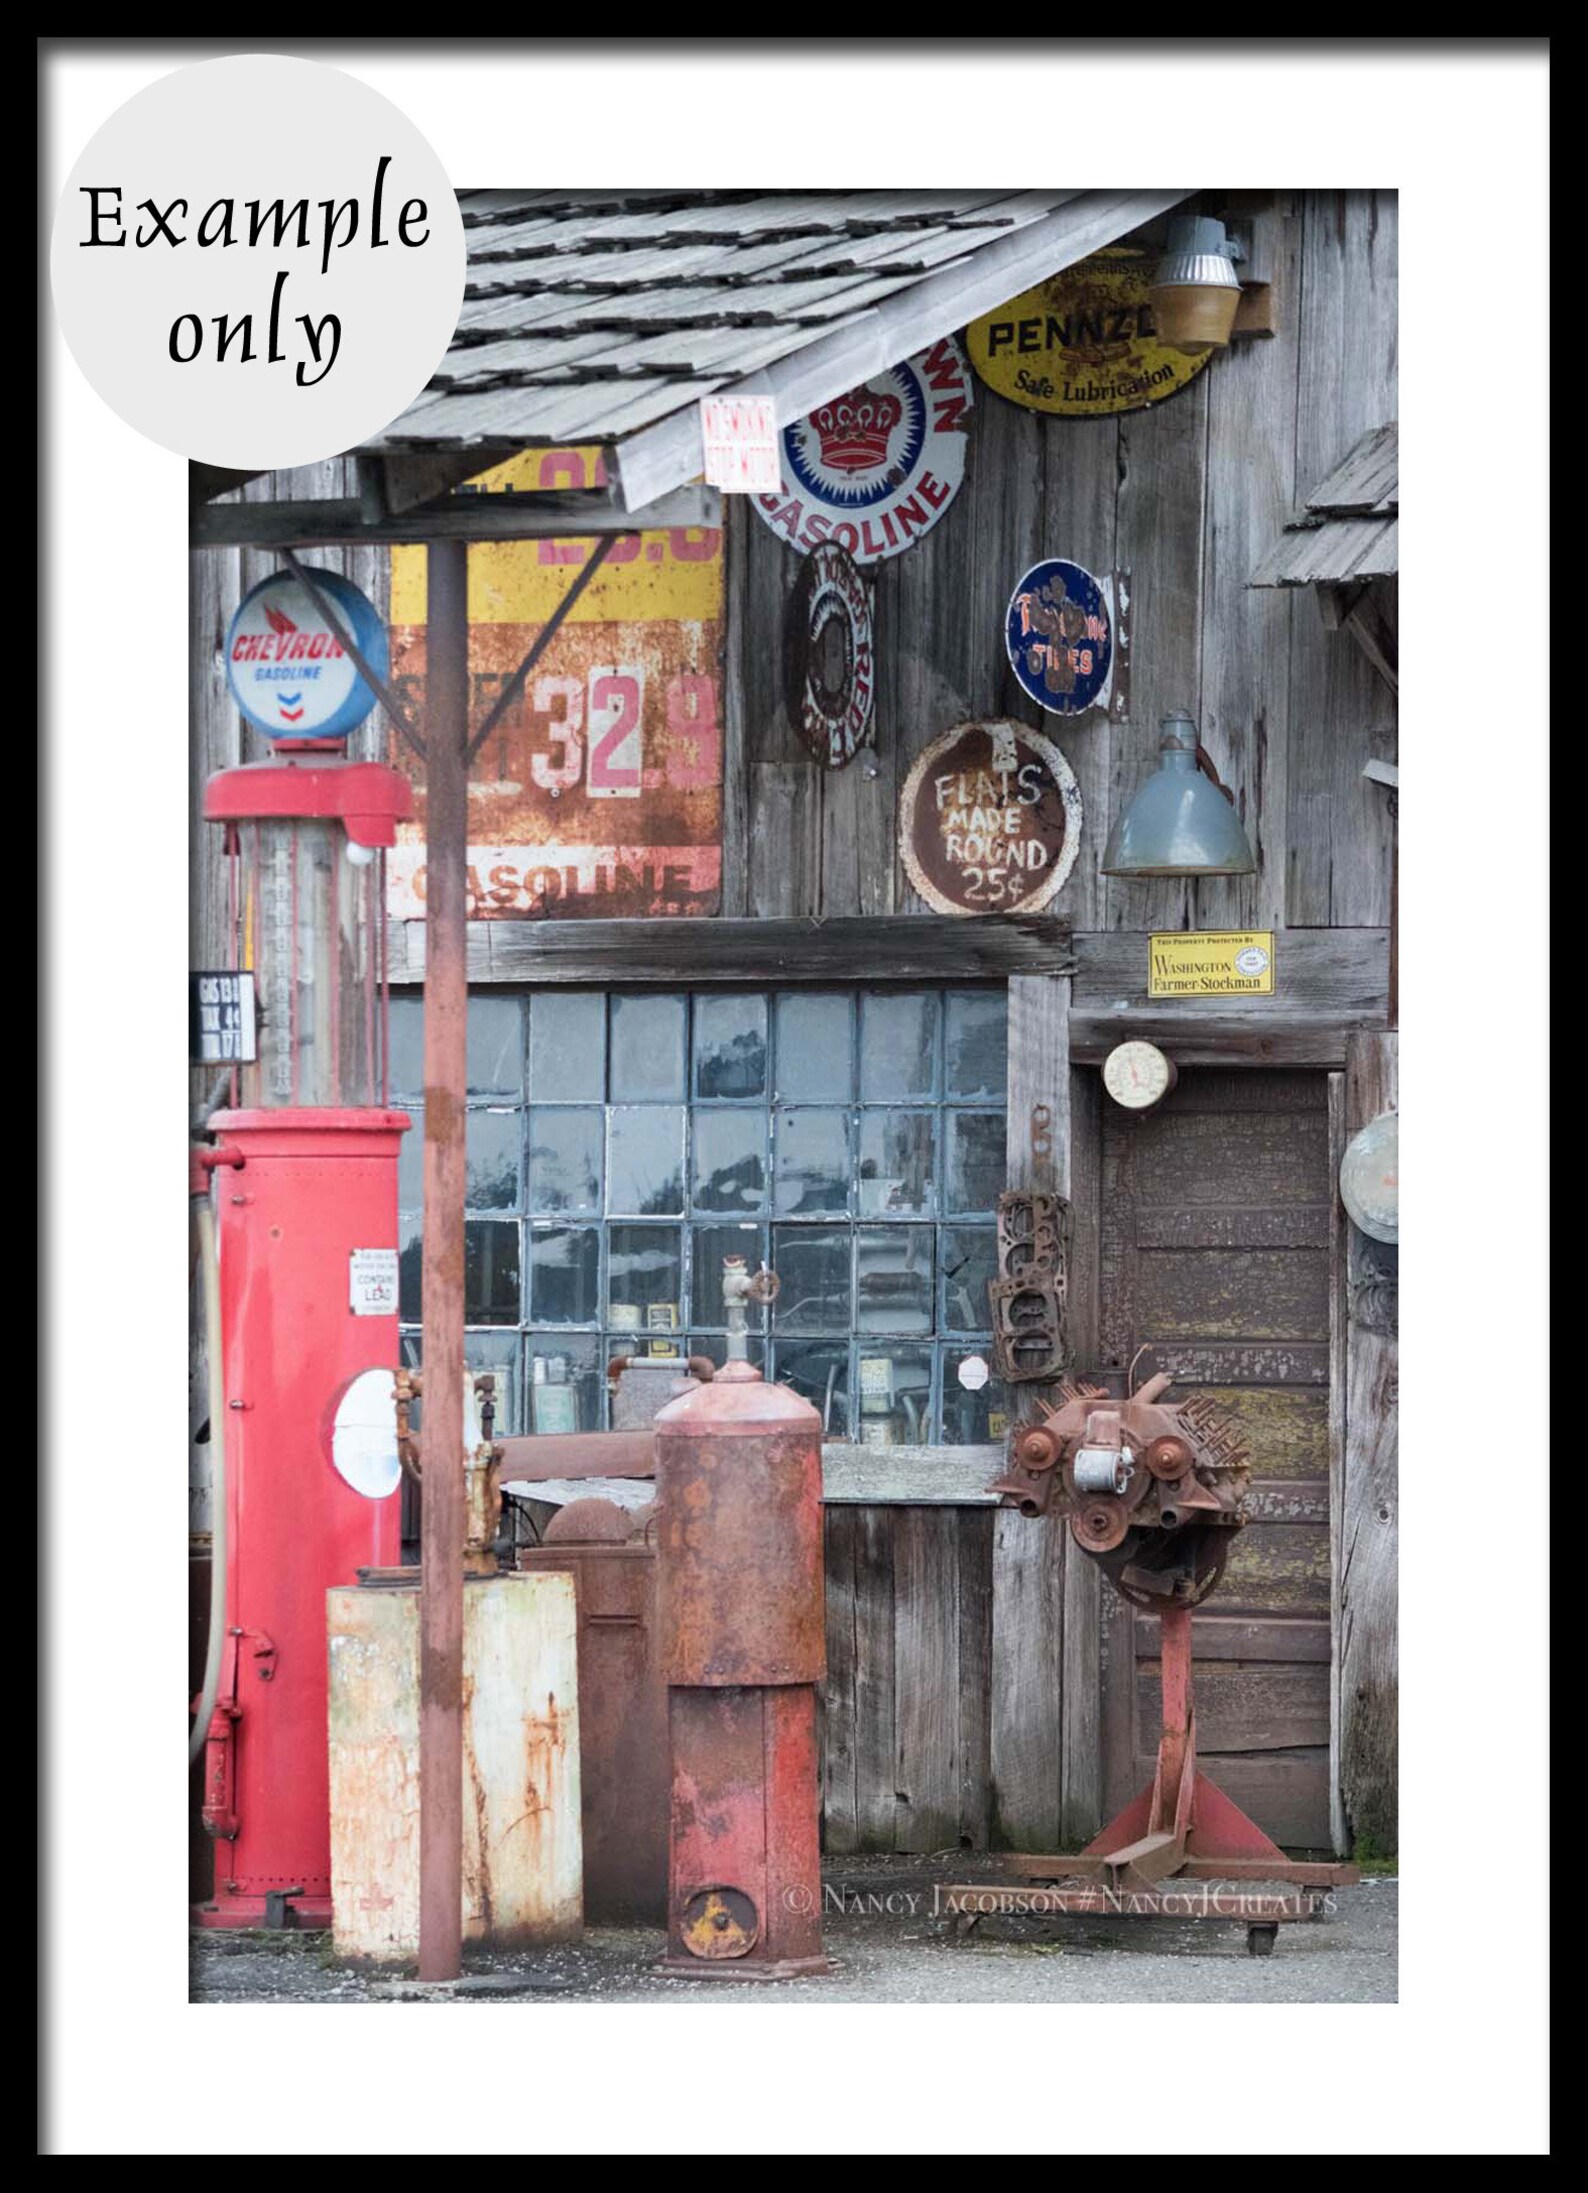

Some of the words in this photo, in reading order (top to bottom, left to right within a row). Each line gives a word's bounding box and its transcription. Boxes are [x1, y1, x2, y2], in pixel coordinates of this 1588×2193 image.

[1014, 369, 1054, 398] Safe
[1063, 364, 1175, 401] Lubrication
[231, 633, 346, 662] CHEVRON
[255, 665, 322, 681] GASOLINE
[946, 806, 1021, 834] MADE
[946, 834, 1048, 870] ROUND
[962, 867, 1025, 901] 25¢
